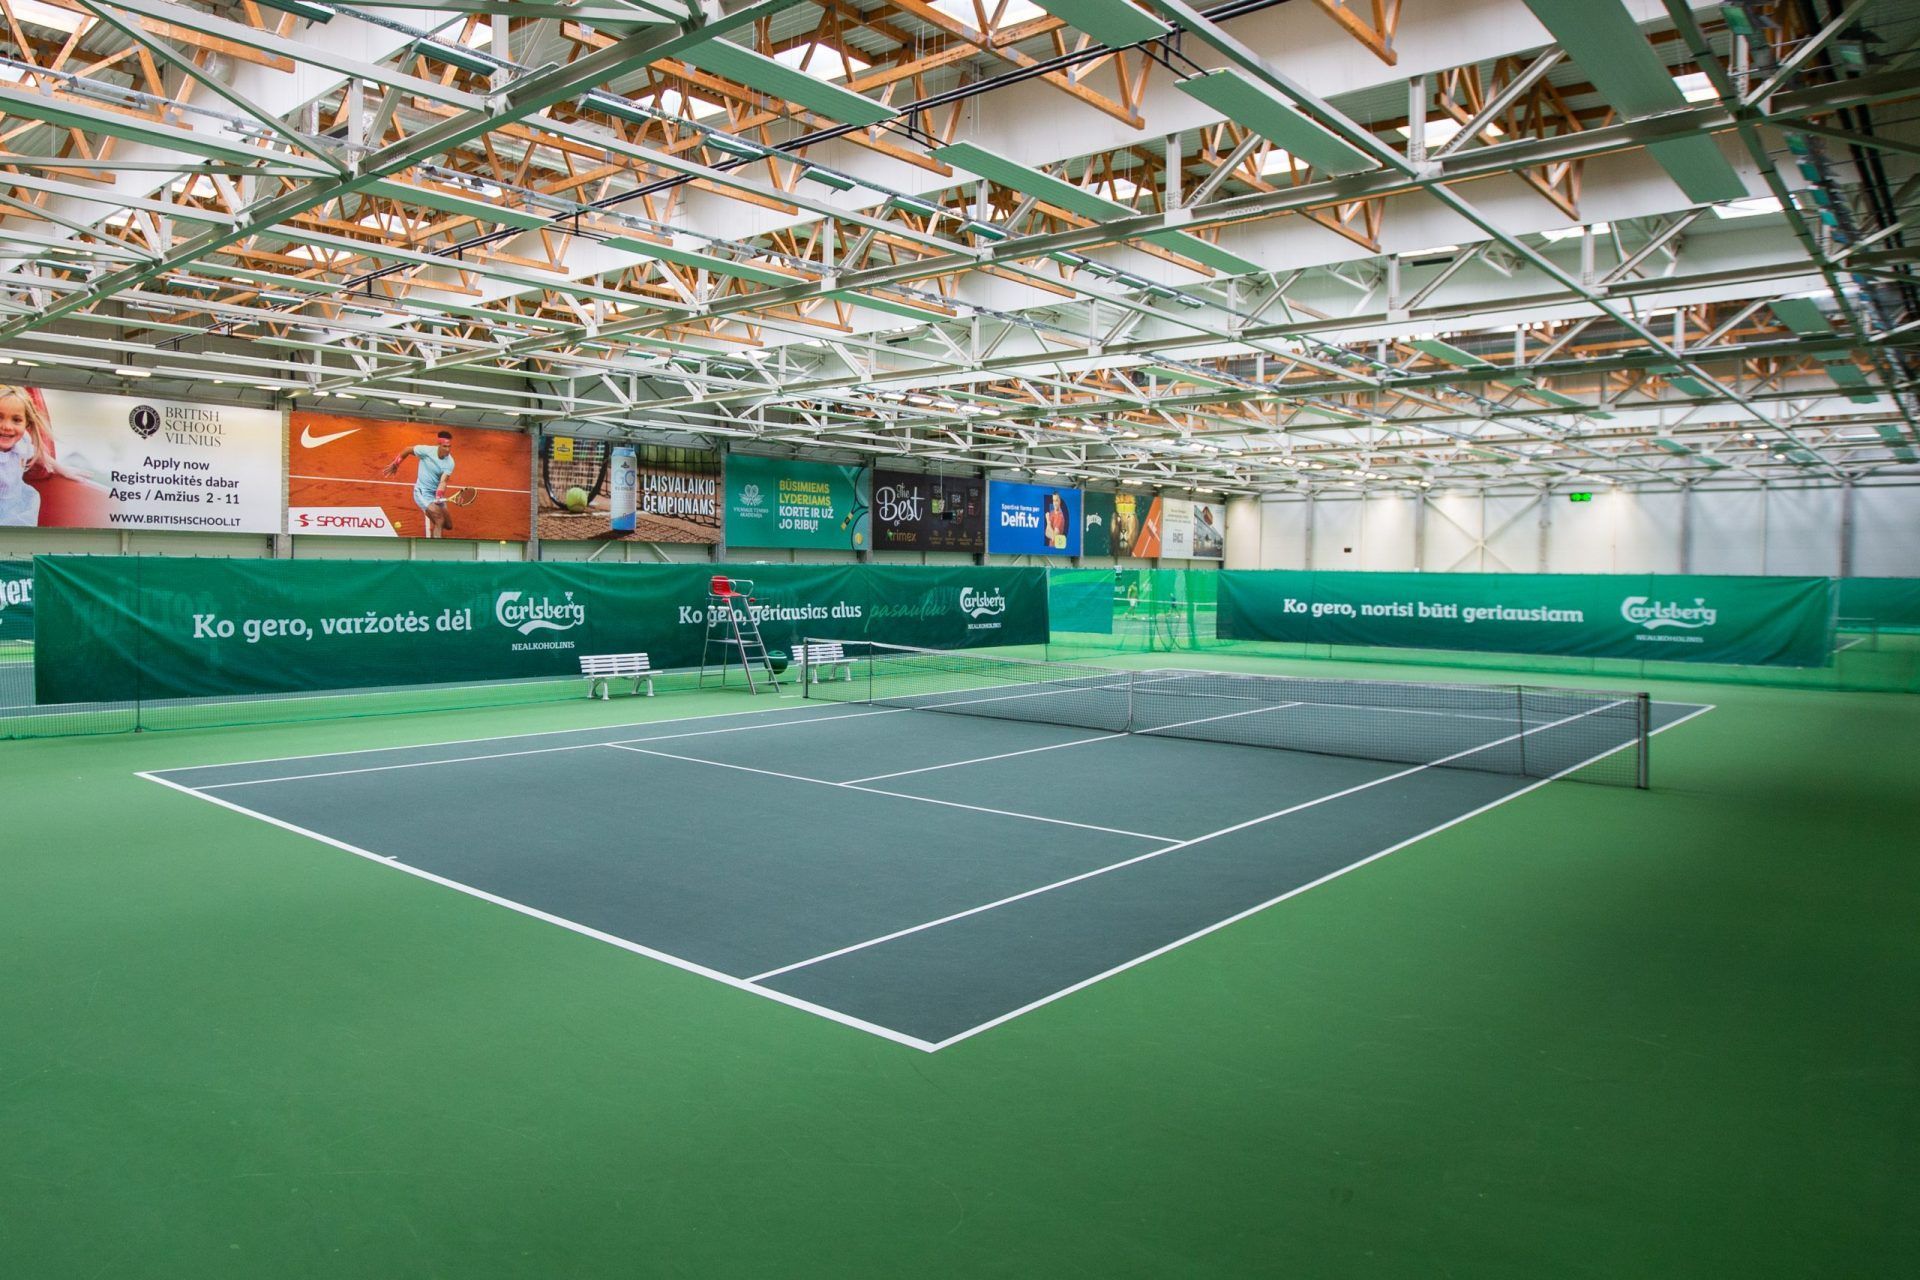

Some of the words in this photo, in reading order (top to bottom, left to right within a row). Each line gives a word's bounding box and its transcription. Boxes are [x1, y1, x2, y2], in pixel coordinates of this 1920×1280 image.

[165, 406, 219, 422] BRITISH
[165, 420, 226, 436] SCHOOL
[165, 432, 222, 448] VILNIUS
[143, 456, 180, 471] Apply
[183, 461, 210, 471] now
[111, 471, 202, 487] Registruokitės
[205, 476, 239, 489] dabar
[643, 474, 715, 495] LAISVALAIKIO
[779, 479, 830, 493] BŪSIMIEMS
[109, 488, 141, 502] Ages
[145, 489, 152, 501] /
[154, 489, 200, 503] Amžius
[206, 492, 214, 504] 2
[225, 493, 240, 505] 11
[896, 482, 910, 499] The
[643, 492, 716, 515] ČEMPIONAMS
[779, 493, 831, 506] LYDERIAMS
[876, 486, 925, 521] Best
[109, 513, 241, 527] WWW.BRITISHSCHOOL.LT
[779, 506, 809, 518] KORTE
[811, 507, 820, 518] IR
[822, 506, 834, 519] UŽ
[1000, 511, 1040, 529] Delfi.tv
[316, 515, 385, 529] SPORTLAND
[779, 519, 792, 530] JO
[794, 519, 818, 533] RIBŲ!
[959, 586, 1006, 614] Carlsberg
[495, 591, 586, 630] Carlsberg
[678, 605, 703, 624] Ko
[753, 604, 829, 626] geriausias
[832, 601, 862, 618] alus
[1283, 598, 1308, 613] Ko
[1311, 601, 1357, 619] gero,
[1361, 602, 1414, 618] norisi
[1418, 602, 1458, 619] būti
[1462, 604, 1584, 623] geriausiam
[1620, 596, 1718, 627] Carlsberg
[193, 614, 235, 639] Ko
[243, 617, 314, 643] gero,
[320, 611, 430, 635] varžotės
[436, 607, 472, 632] dėl
[511, 641, 575, 651] NEALKOHOLINIS
